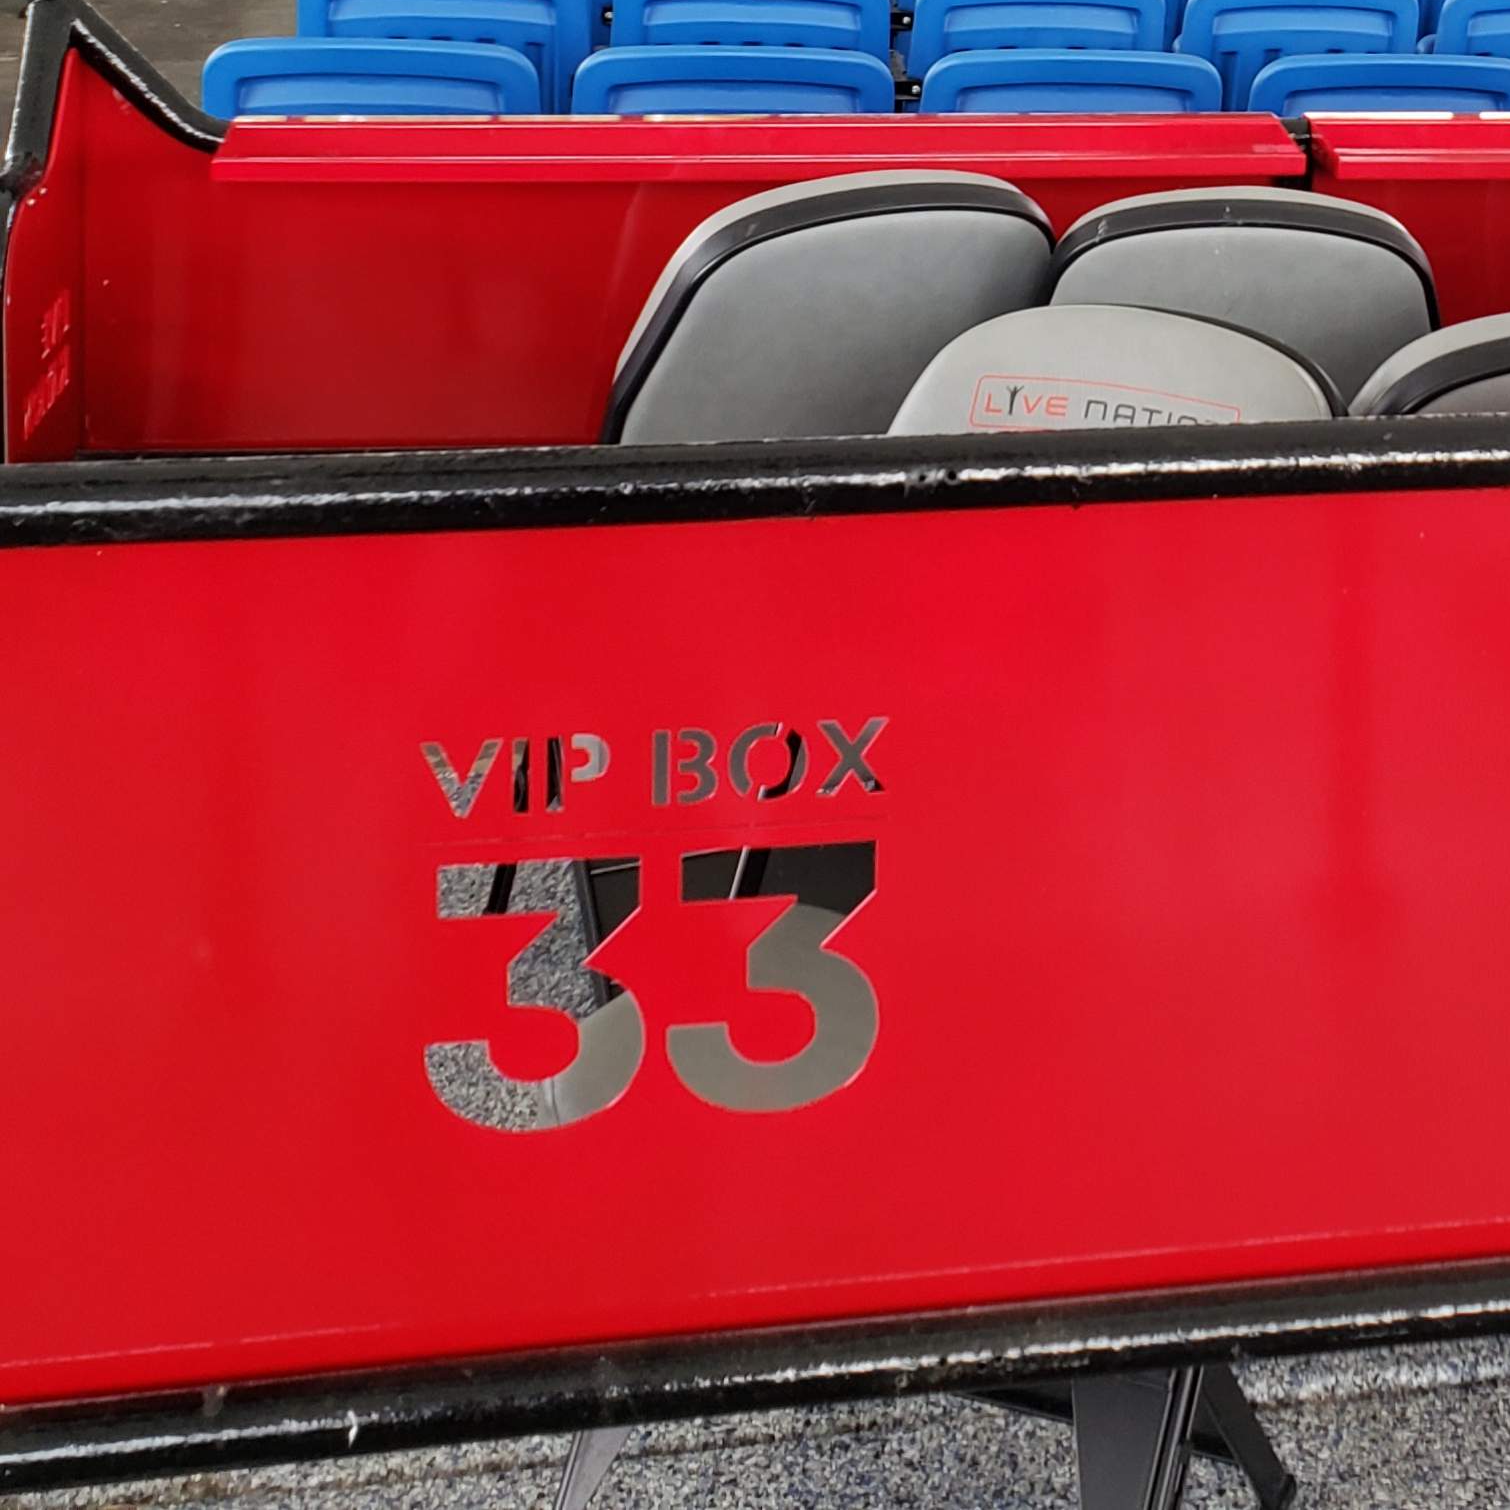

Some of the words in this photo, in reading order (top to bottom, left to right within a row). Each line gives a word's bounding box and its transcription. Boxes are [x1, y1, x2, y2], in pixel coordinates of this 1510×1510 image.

[983, 385, 1069, 417] LIVE
[419, 733, 612, 819] VIP
[650, 716, 890, 808] BOX
[422, 839, 880, 1133] 33
